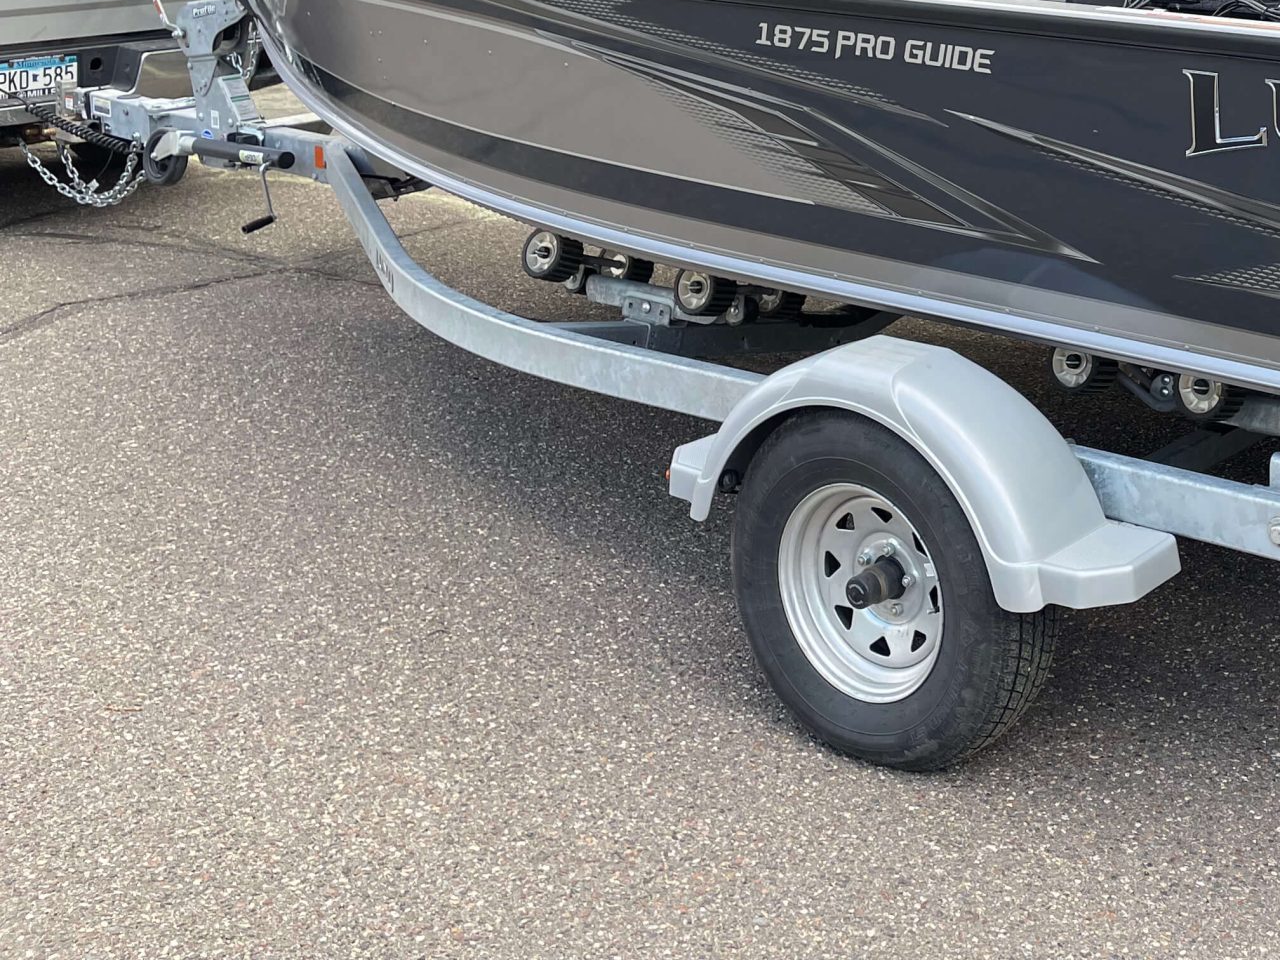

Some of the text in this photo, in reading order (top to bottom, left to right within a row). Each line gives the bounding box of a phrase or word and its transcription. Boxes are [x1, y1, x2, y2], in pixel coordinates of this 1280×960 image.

[755, 22, 995, 74] 1875 PRO GUIDE
[43, 65, 74, 86] 585
